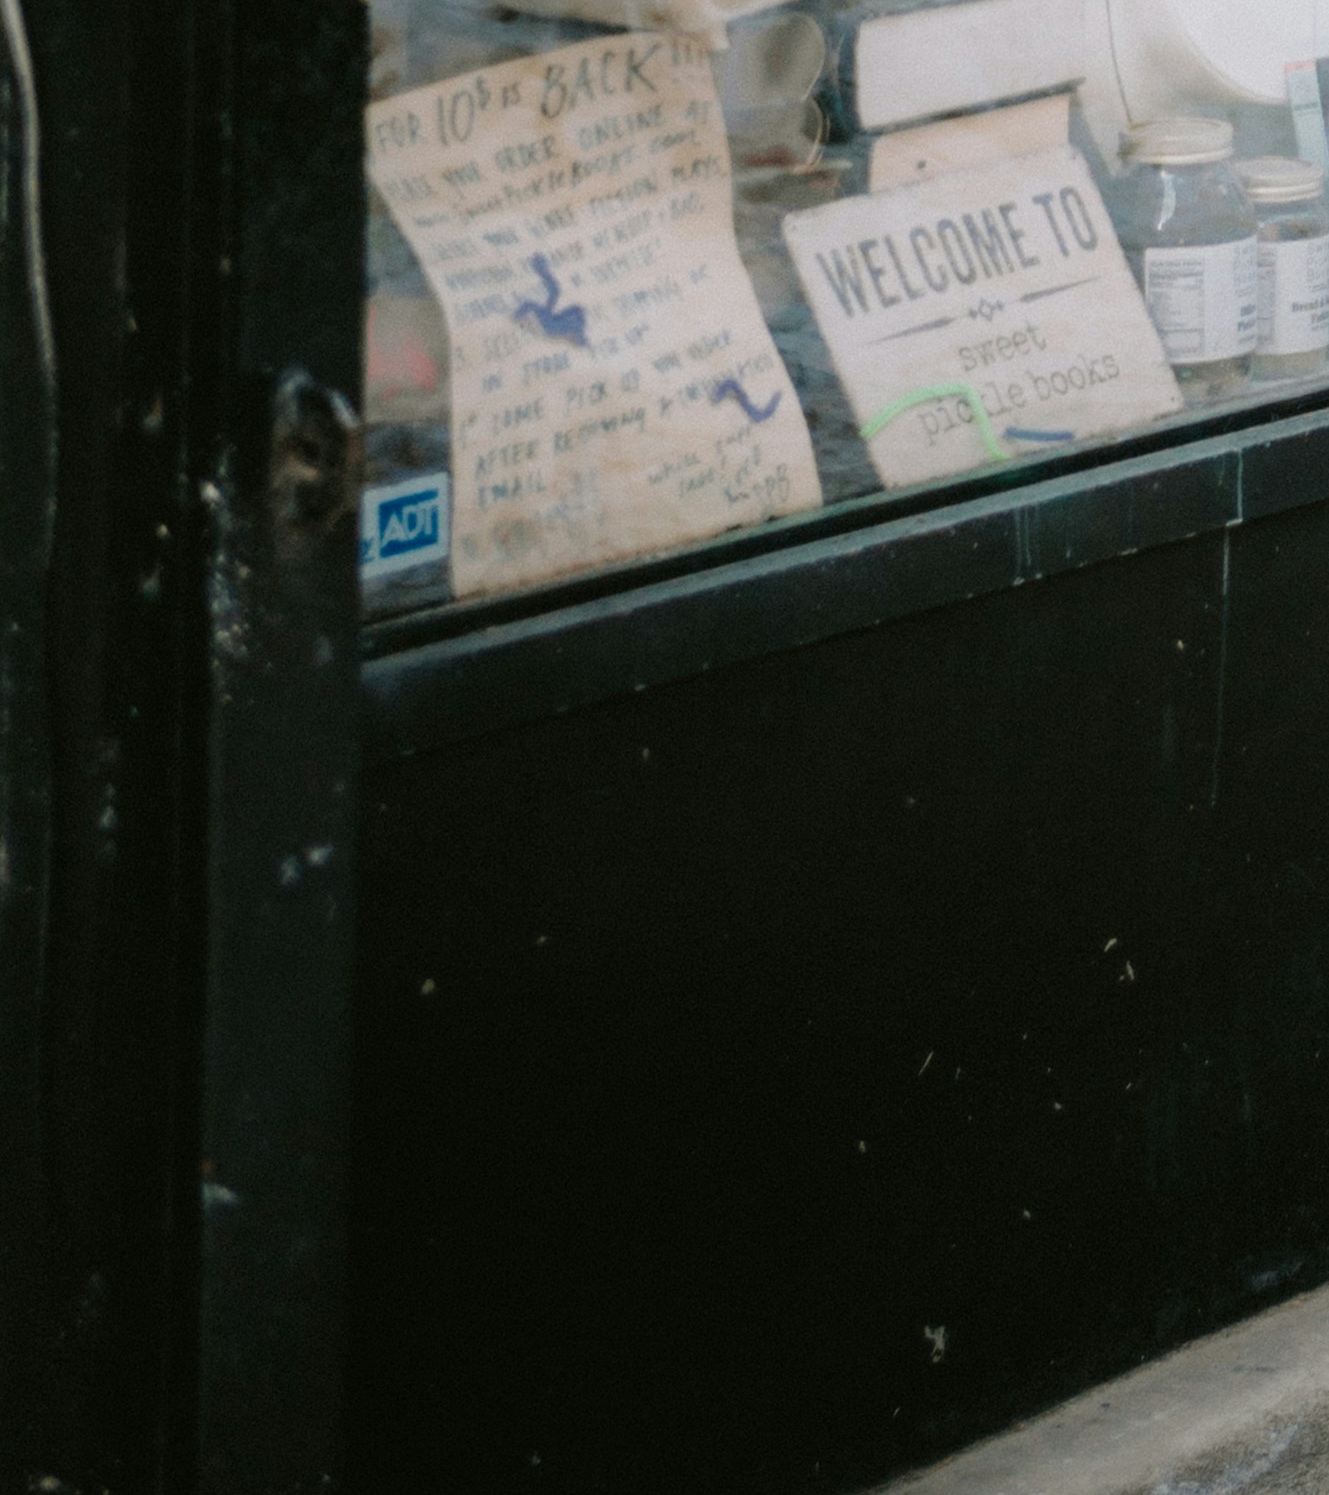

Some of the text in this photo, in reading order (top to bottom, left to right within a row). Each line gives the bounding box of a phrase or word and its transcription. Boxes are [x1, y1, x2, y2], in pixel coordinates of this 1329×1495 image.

[501, 81, 523, 109] IS
[539, 42, 662, 121] BACK
[815, 200, 1040, 319] WELCOME
[1032, 185, 1099, 260] TO
[958, 320, 1048, 373] sweet
[1024, 353, 1121, 401] books
[381, 497, 438, 546] ADT
